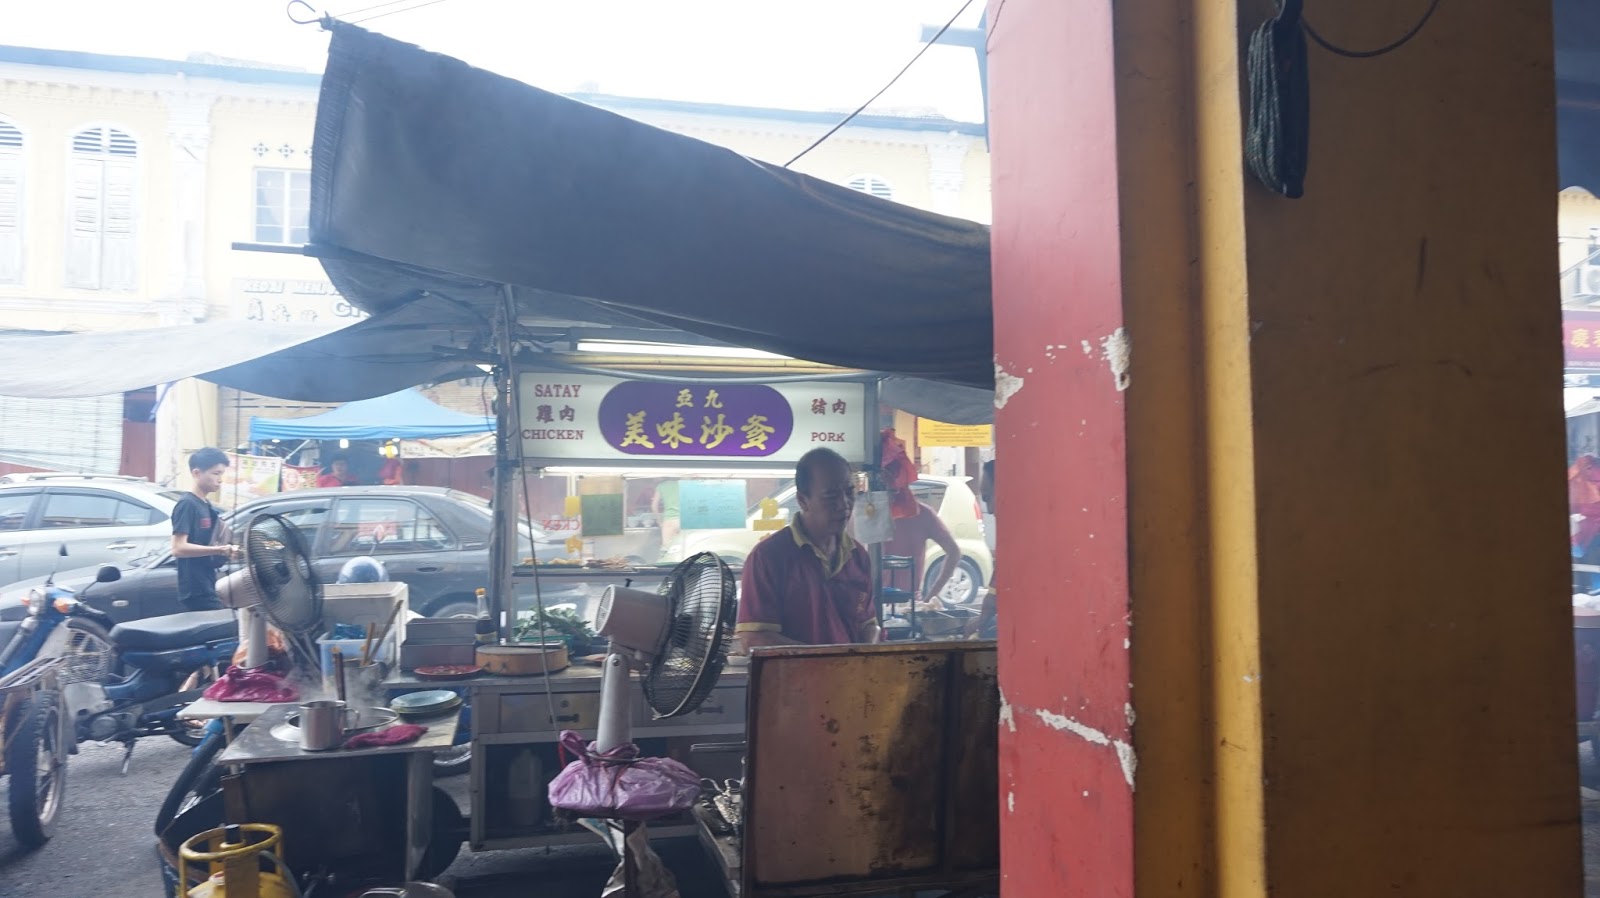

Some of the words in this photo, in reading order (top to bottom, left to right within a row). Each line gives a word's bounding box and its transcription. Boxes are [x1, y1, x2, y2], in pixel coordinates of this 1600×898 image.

[534, 384, 582, 398] SATAY
[521, 429, 584, 440] CHICKEN
[619, 410, 775, 450] 美味沙爹
[811, 432, 845, 442] PORK
